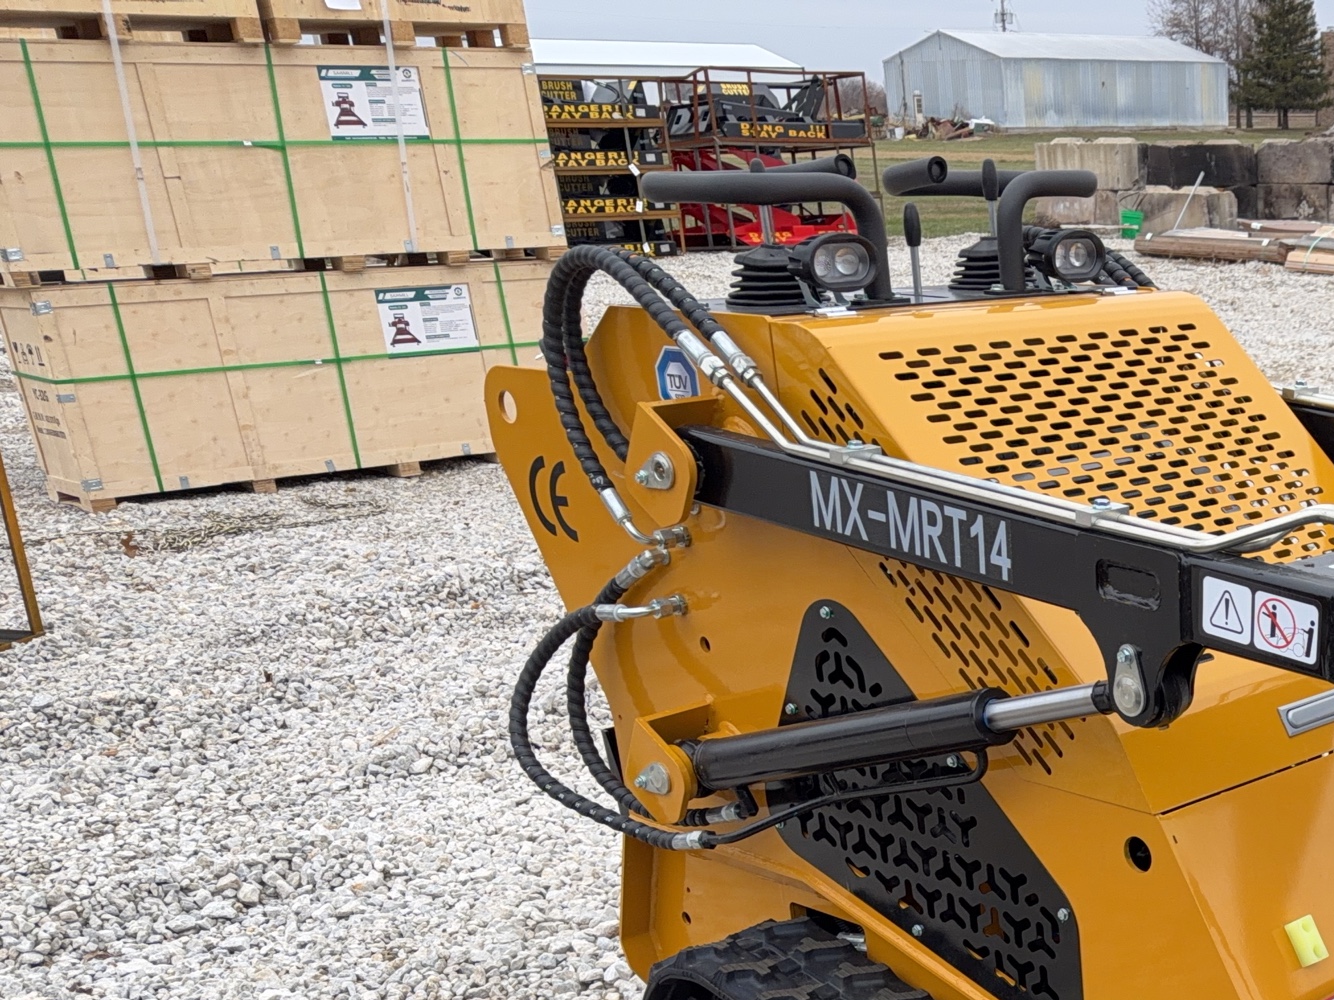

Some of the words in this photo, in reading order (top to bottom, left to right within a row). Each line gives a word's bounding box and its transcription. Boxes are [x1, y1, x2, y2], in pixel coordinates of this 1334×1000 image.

[541, 80, 573, 91] BRUSH
[541, 90, 577, 101] CUTTER
[788, 129, 826, 139] BACK
[552, 159, 589, 168] TAY
[562, 206, 598, 214] TAY
[604, 205, 649, 214] BAC
[666, 373, 688, 390] TÜV
[528, 455, 579, 543] CE
[809, 470, 1012, 581] MX-MRT14
